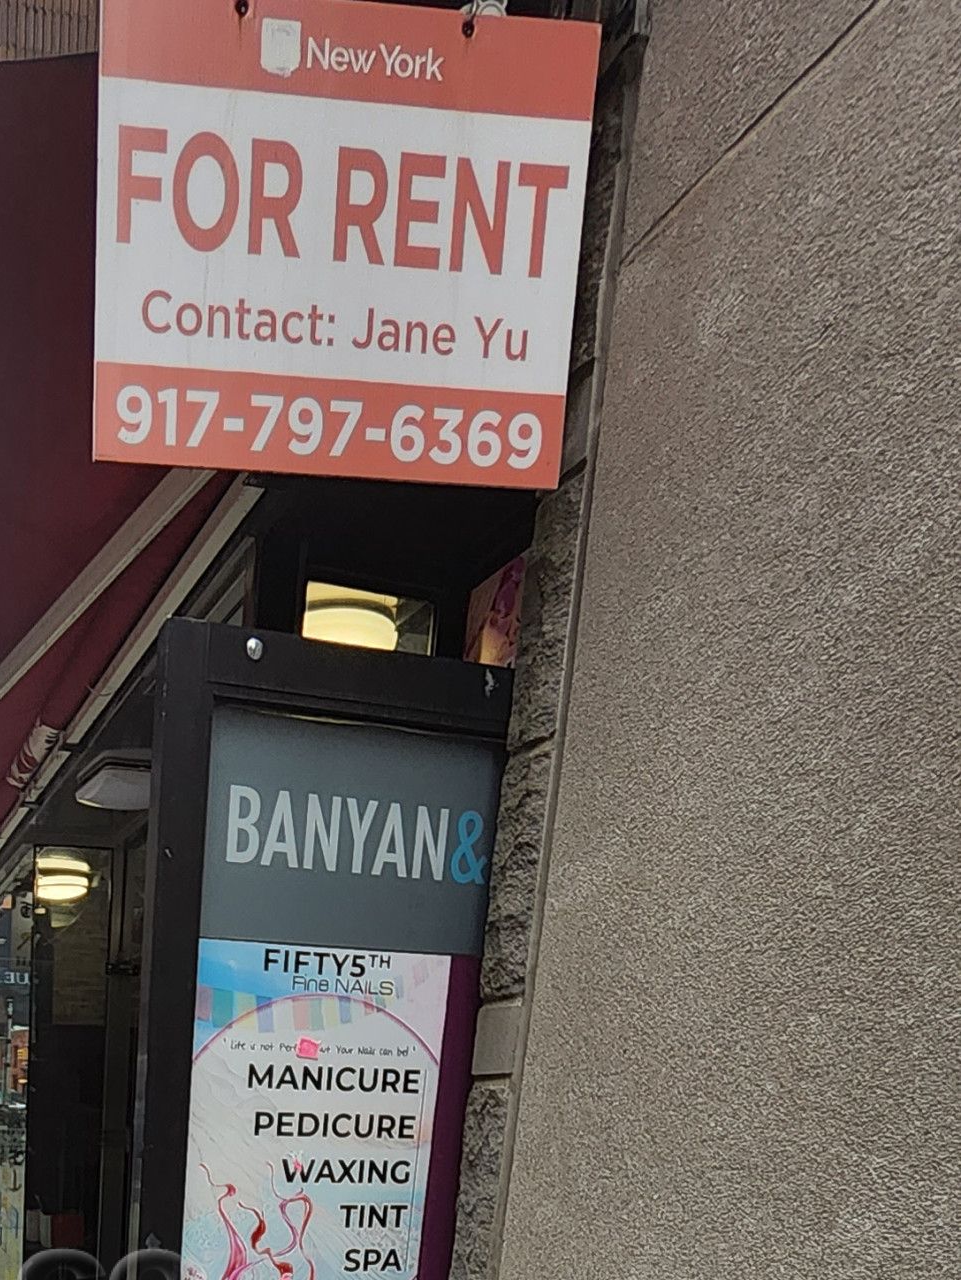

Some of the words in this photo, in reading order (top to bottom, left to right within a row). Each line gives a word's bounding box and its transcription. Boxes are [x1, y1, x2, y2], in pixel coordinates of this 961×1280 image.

[306, 36, 376, 73] New
[379, 43, 443, 82] York
[115, 124, 304, 259] FOR
[332, 146, 570, 279] RENT
[141, 289, 336, 347] Contact:
[352, 307, 456, 356] Jane
[474, 316, 530, 361] Yu
[116, 386, 543, 470] 917-797-6369
[334, 977, 395, 998] NAILS
[247, 1064, 421, 1094] MANICURE
[254, 1111, 415, 1140] PEDICURE
[282, 1158, 411, 1184] WAXING
[340, 1204, 407, 1229] TINT
[343, 1249, 402, 1273] SPA
